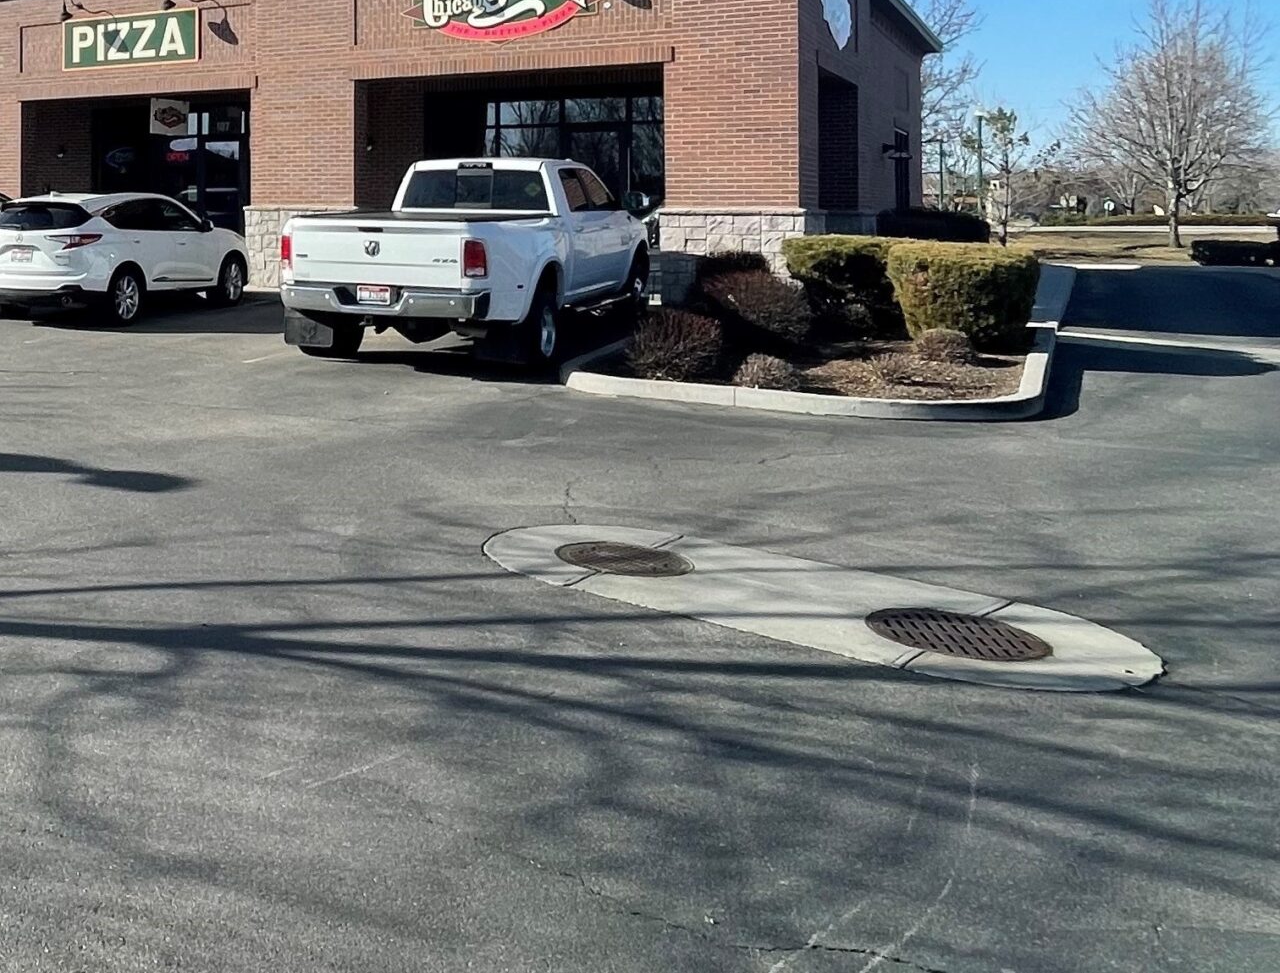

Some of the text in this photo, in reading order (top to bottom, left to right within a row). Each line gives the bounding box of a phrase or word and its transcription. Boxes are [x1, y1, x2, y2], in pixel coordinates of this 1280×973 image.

[72, 17, 186, 64] PIZZA
[451, 25, 469, 34] THE
[484, 26, 528, 36] BETTER
